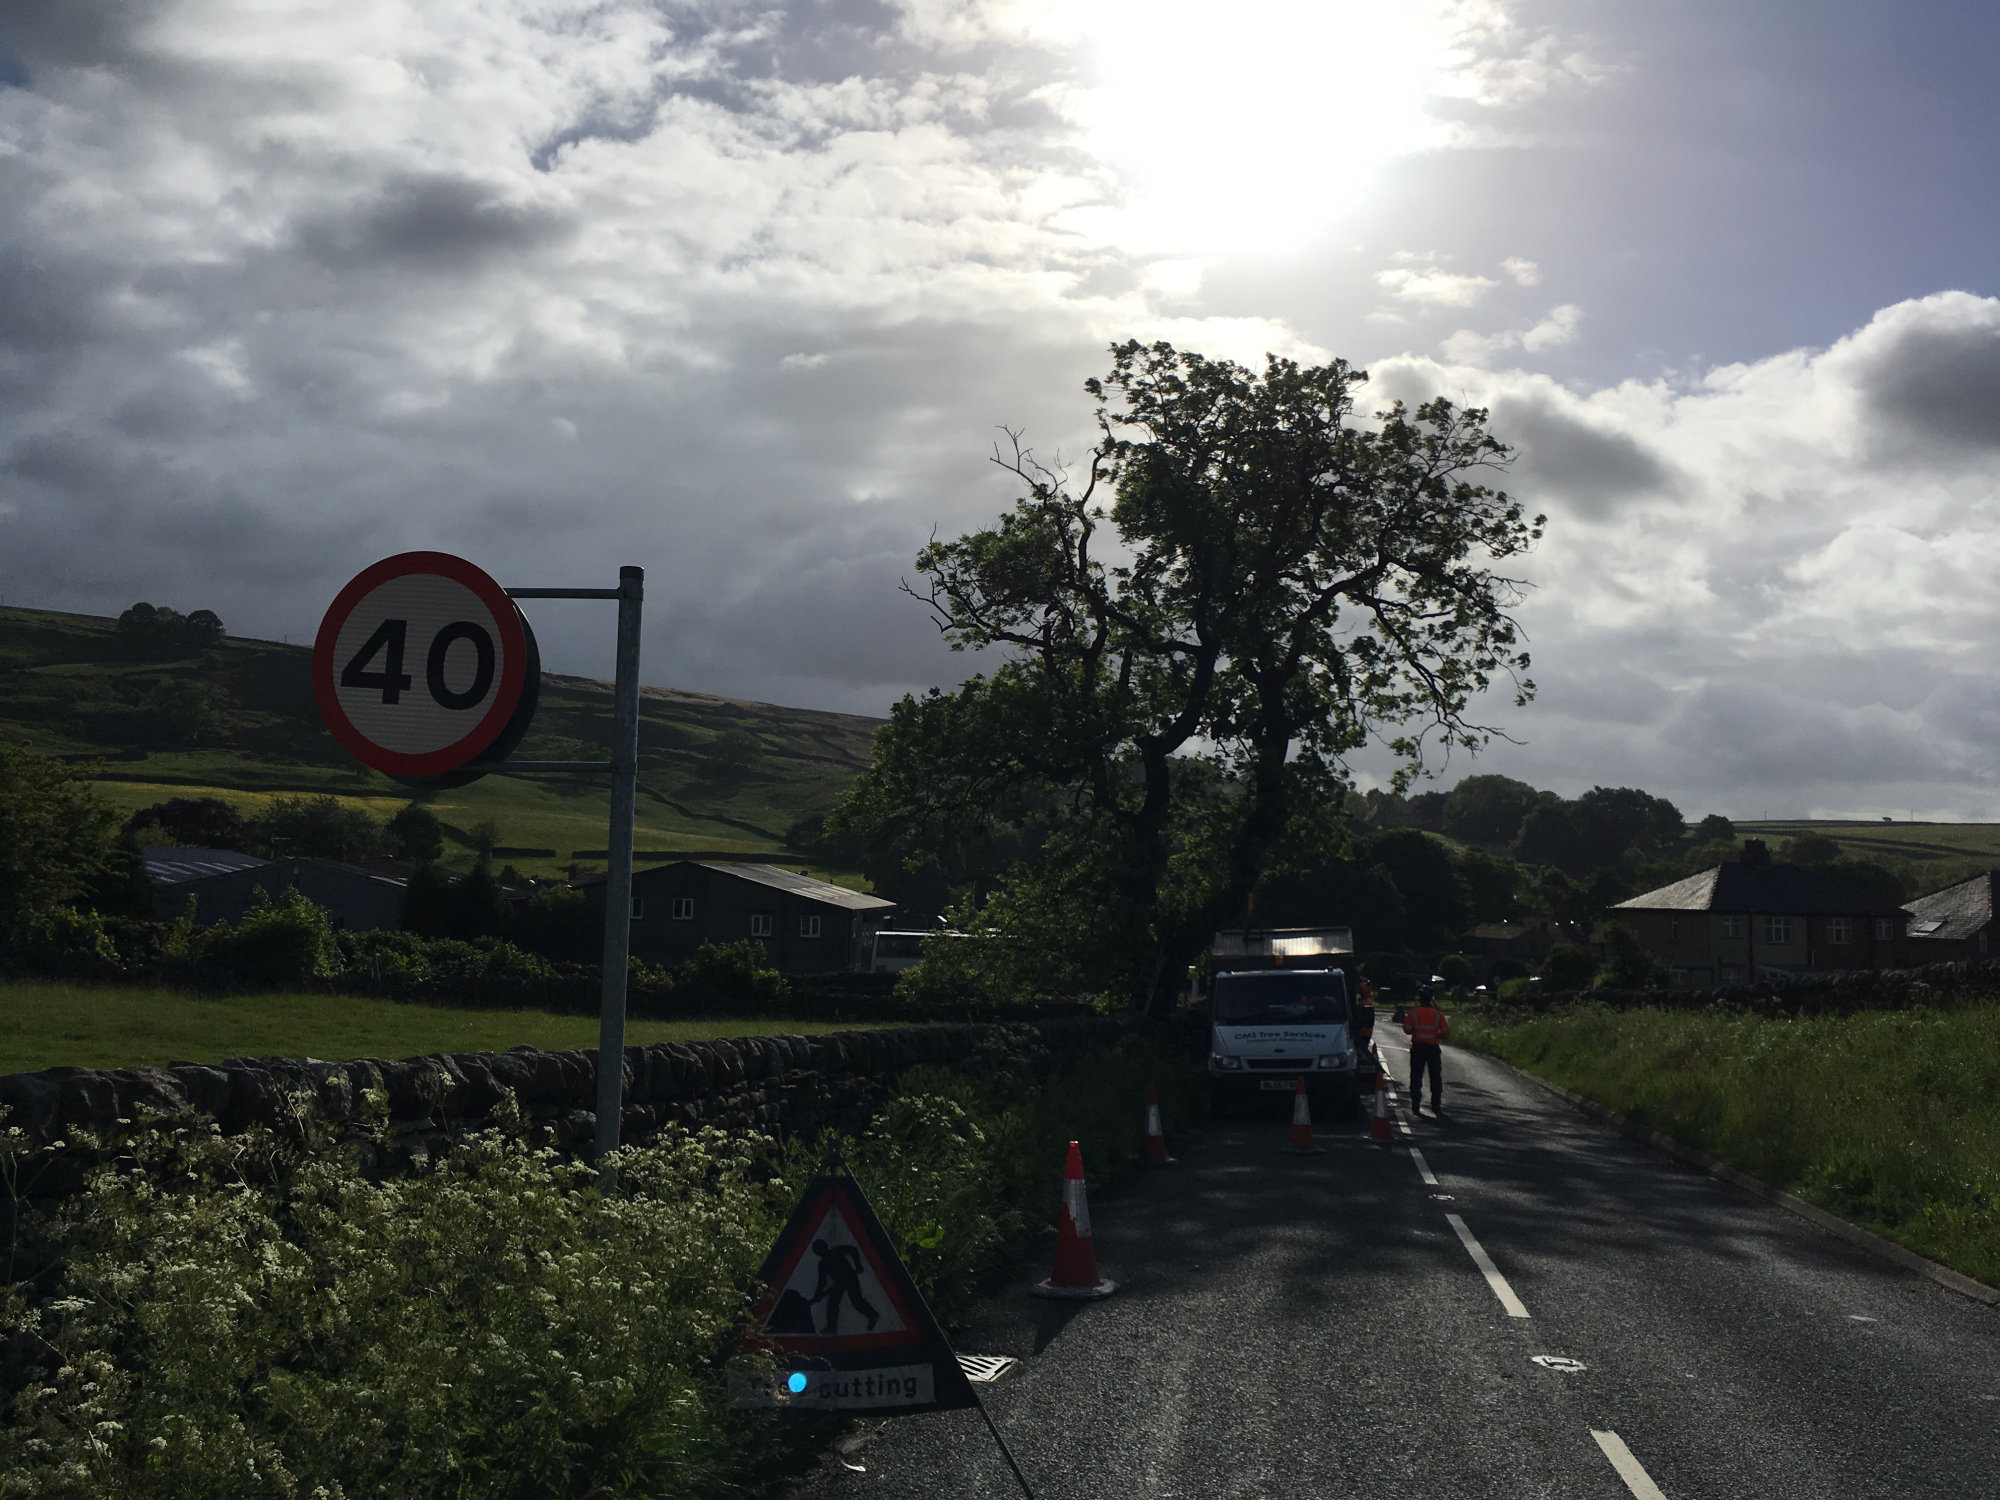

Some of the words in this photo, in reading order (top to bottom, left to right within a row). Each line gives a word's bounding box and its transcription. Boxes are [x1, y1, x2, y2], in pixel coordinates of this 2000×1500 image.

[341, 619, 495, 710] 40
[1260, 1031, 1281, 1039] Tree
[1284, 1030, 1326, 1040] Services
[819, 1373, 918, 1400] cutting
